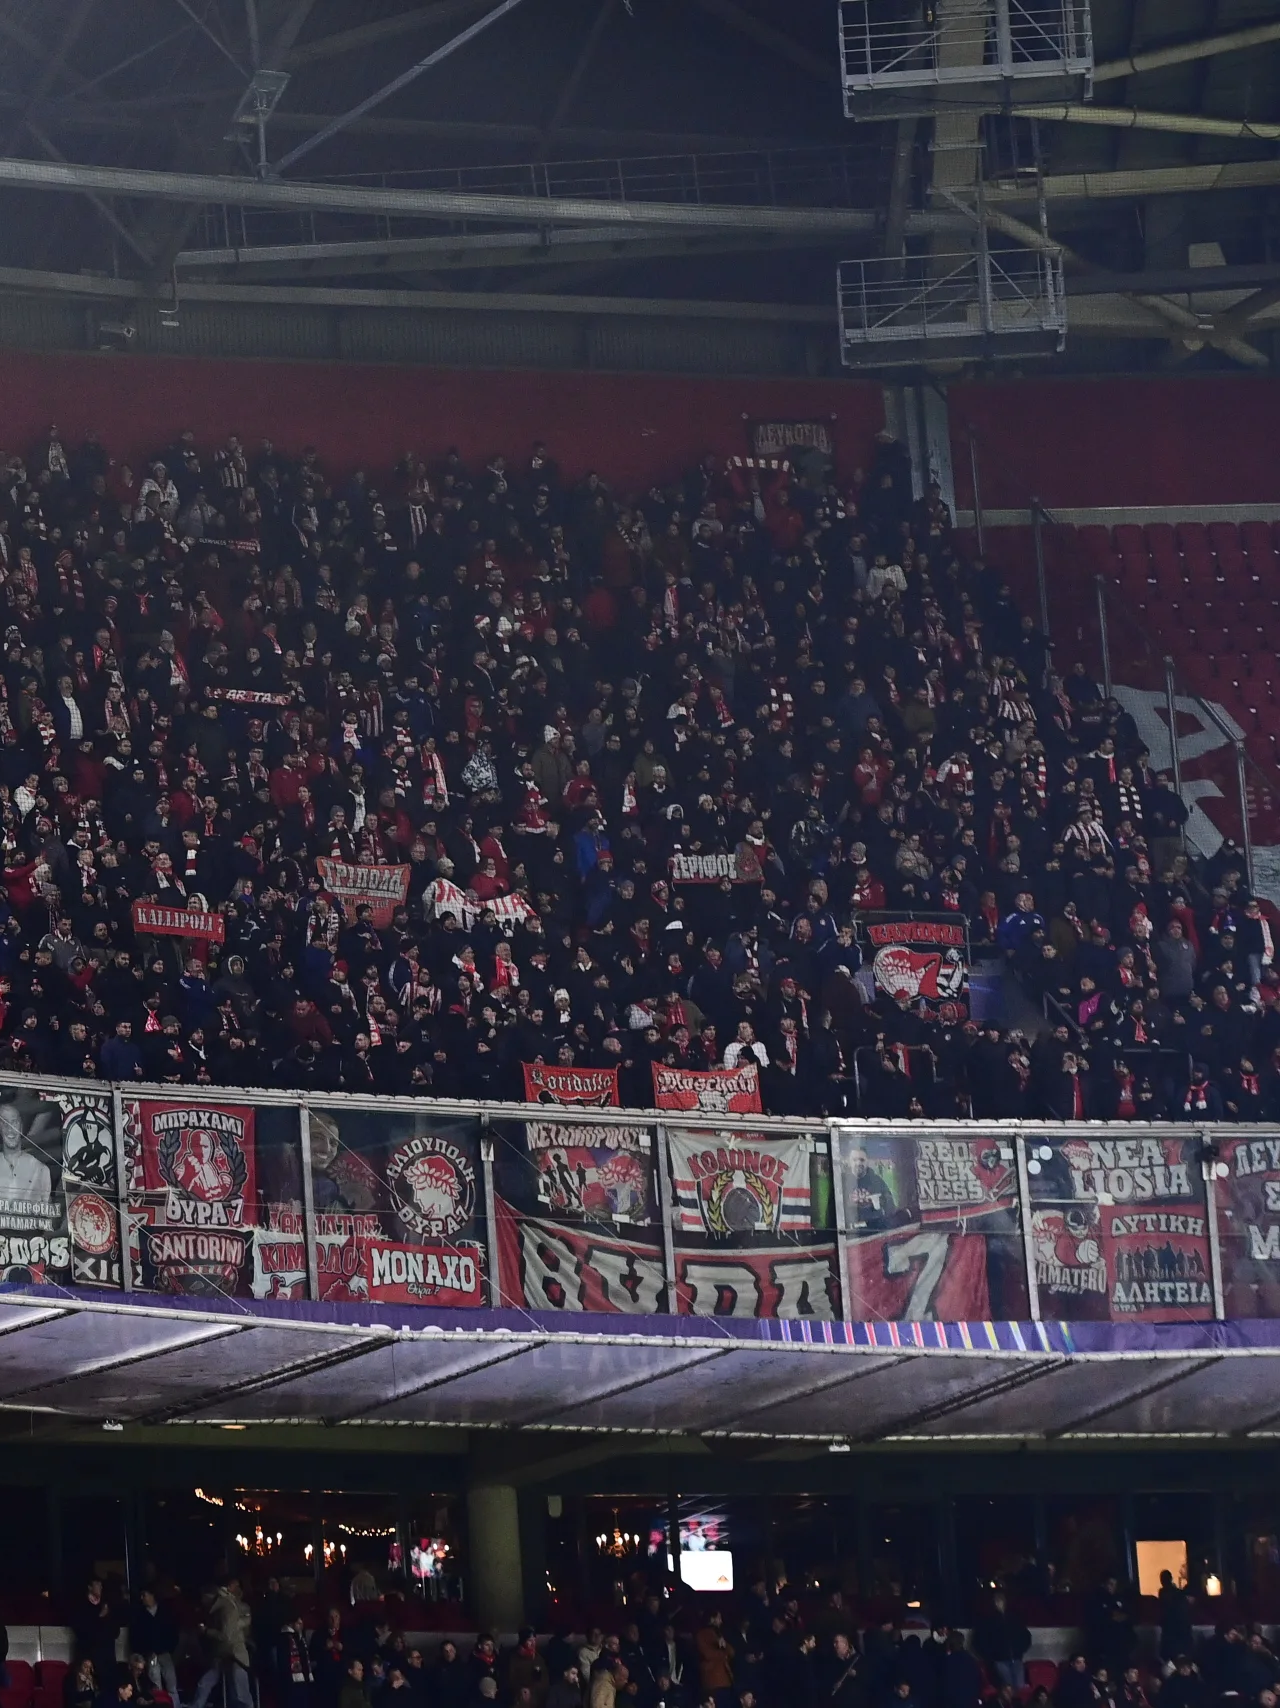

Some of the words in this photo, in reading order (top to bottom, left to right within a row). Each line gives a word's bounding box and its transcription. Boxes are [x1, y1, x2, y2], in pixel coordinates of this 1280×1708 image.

[137, 907, 212, 936] KALLIPOLI
[154, 1110, 244, 1138] ΜΠΡΑΧΑΜΙ
[386, 1135, 475, 1184] ΗΛΙΟΥΠΟΛΗ
[918, 1141, 970, 1162] RED
[1087, 1140, 1163, 1169] NEA
[687, 1149, 789, 1184] ΚΟΛΩΝΟΣ
[918, 1158, 976, 1181] SICK
[919, 1179, 985, 1201] NESS
[1072, 1162, 1191, 1201] LIOSIA
[167, 1198, 229, 1226] ΘΥΡΑ
[232, 1198, 244, 1223] 7
[396, 1206, 462, 1238] ΘΥΡΑ
[1111, 1214, 1203, 1237] ΔΥΤΙΚΗ
[149, 1232, 245, 1266] SANTORINI
[371, 1248, 476, 1293] ΜΟΝΑΧΟ
[885, 1234, 949, 1321] 7
[1112, 1281, 1211, 1305] ΑΛΗΤΕΙΑ
